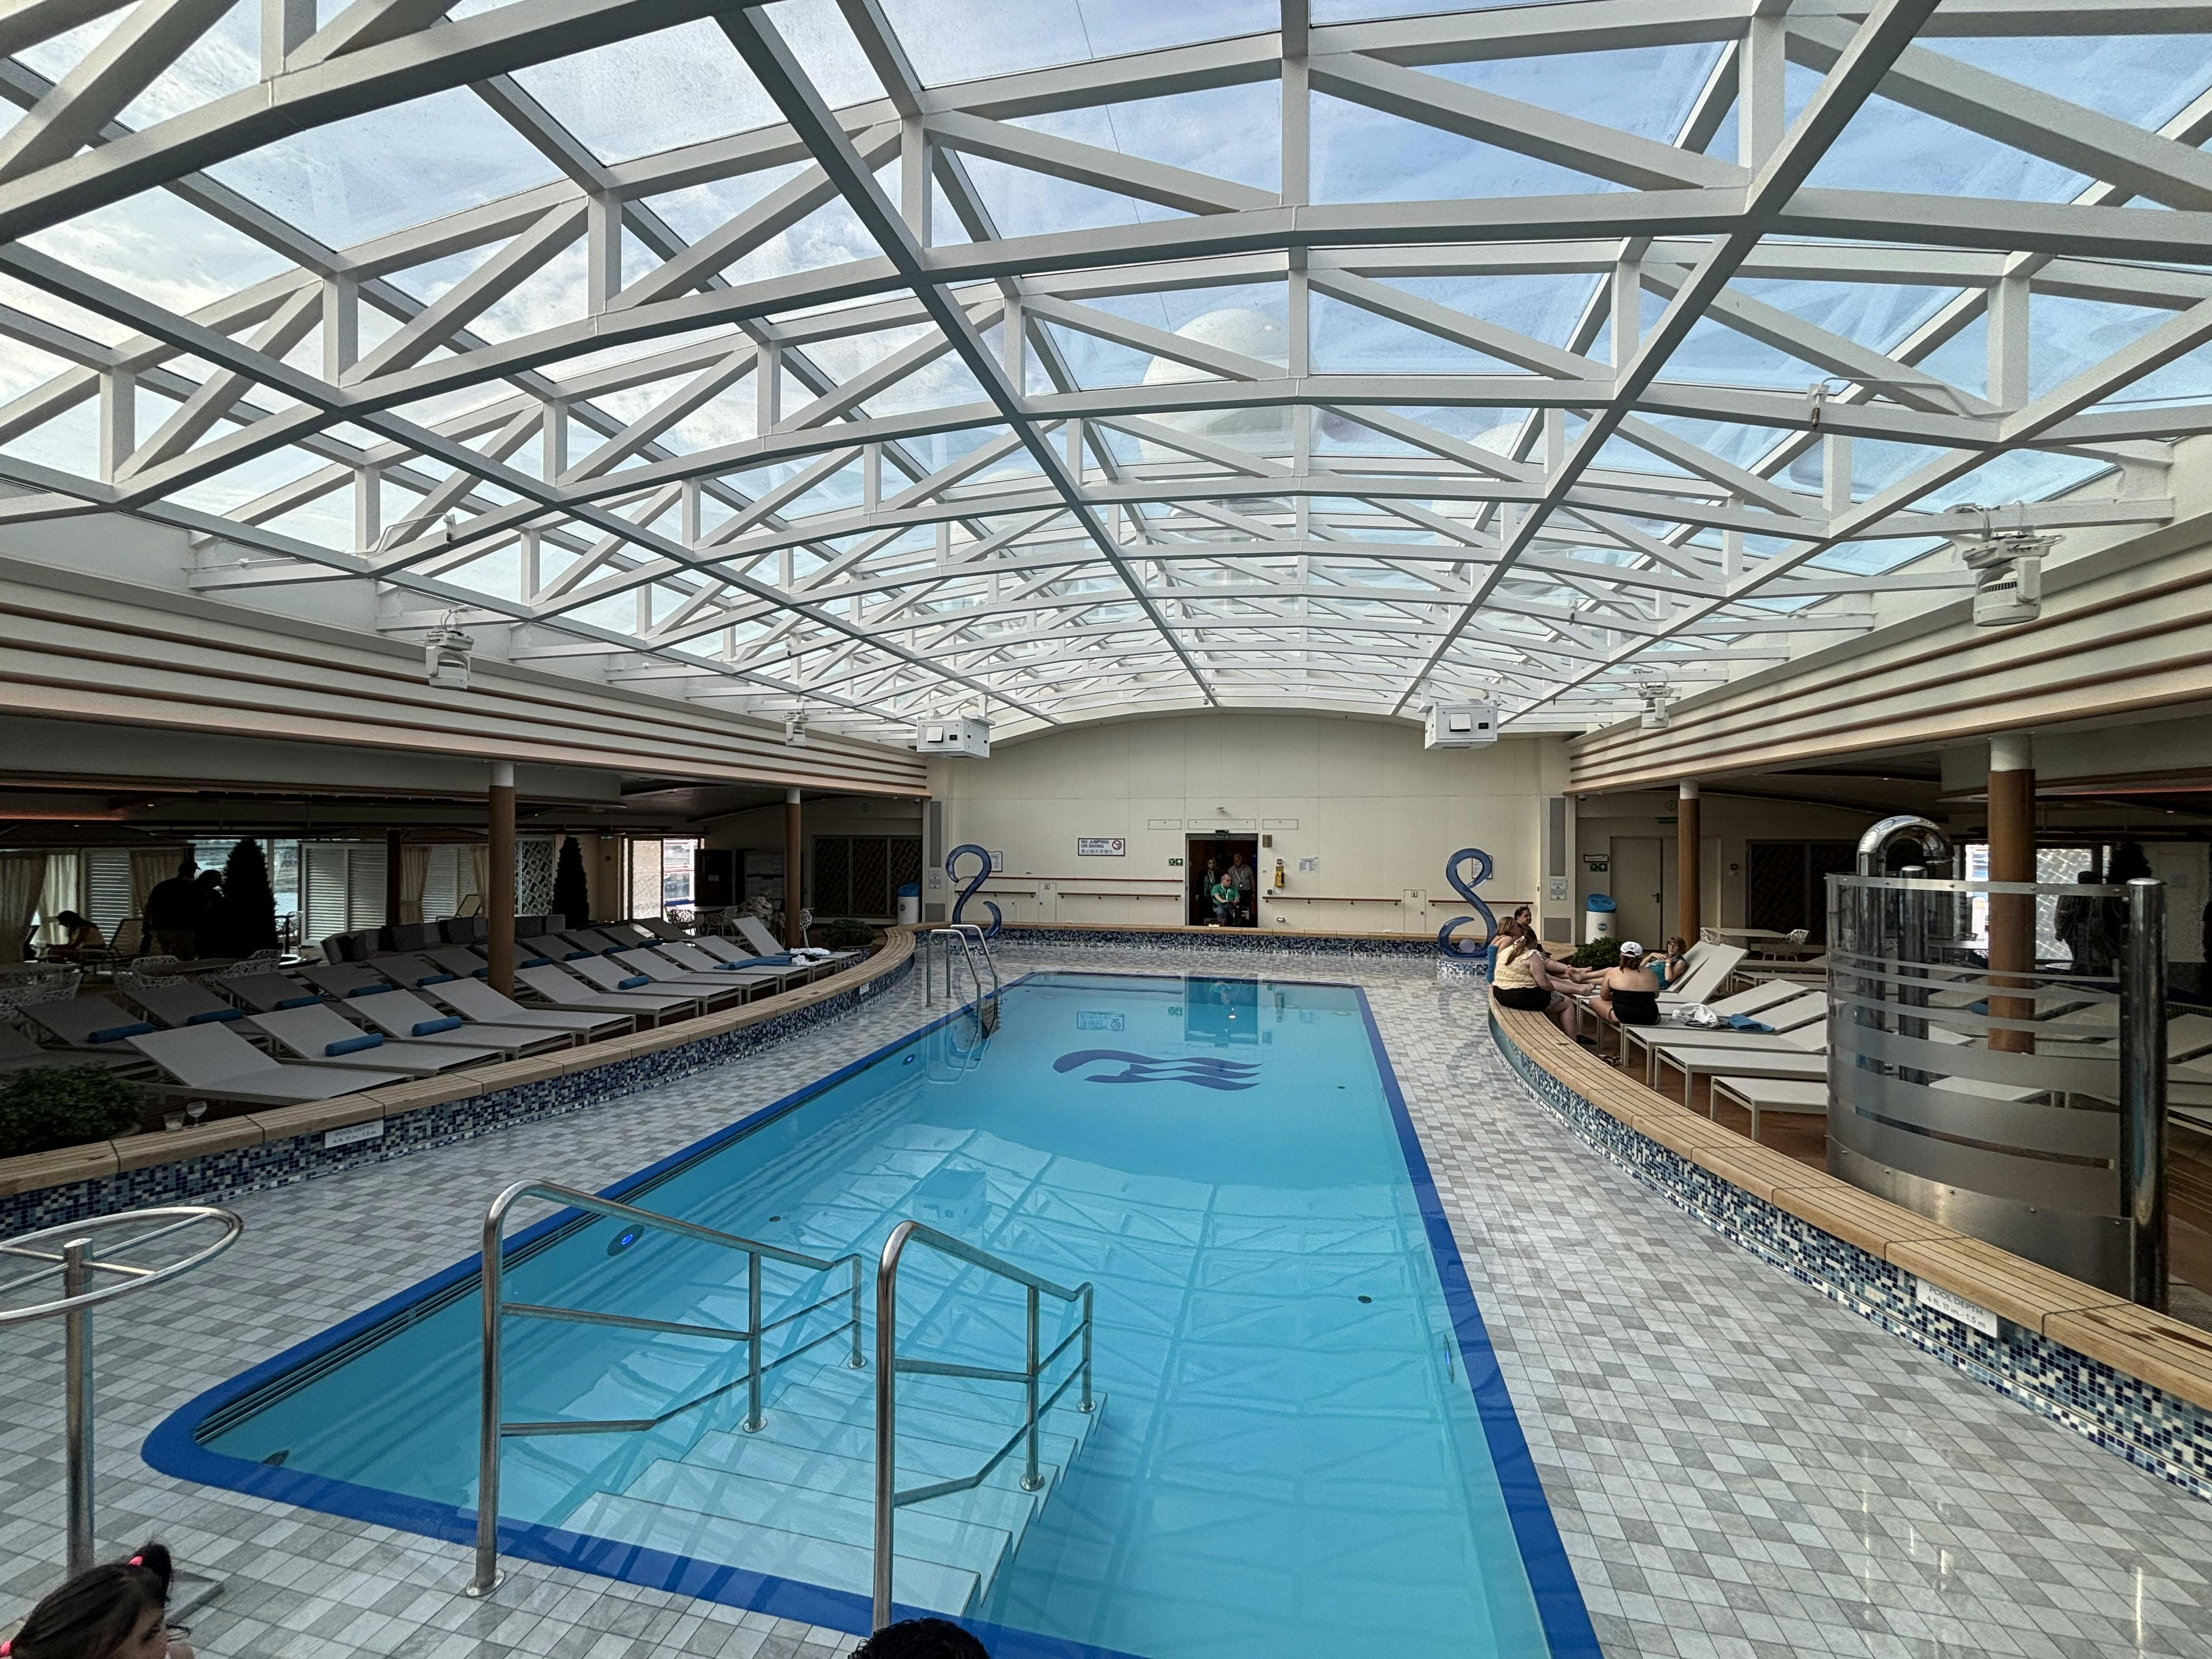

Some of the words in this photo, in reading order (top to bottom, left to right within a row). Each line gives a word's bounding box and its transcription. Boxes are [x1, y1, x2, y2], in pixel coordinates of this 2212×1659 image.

[1928, 1285, 1953, 1302] POOL
[1954, 1298, 1983, 1316] DEPTH
[1966, 1314, 1976, 1324] 1.5
